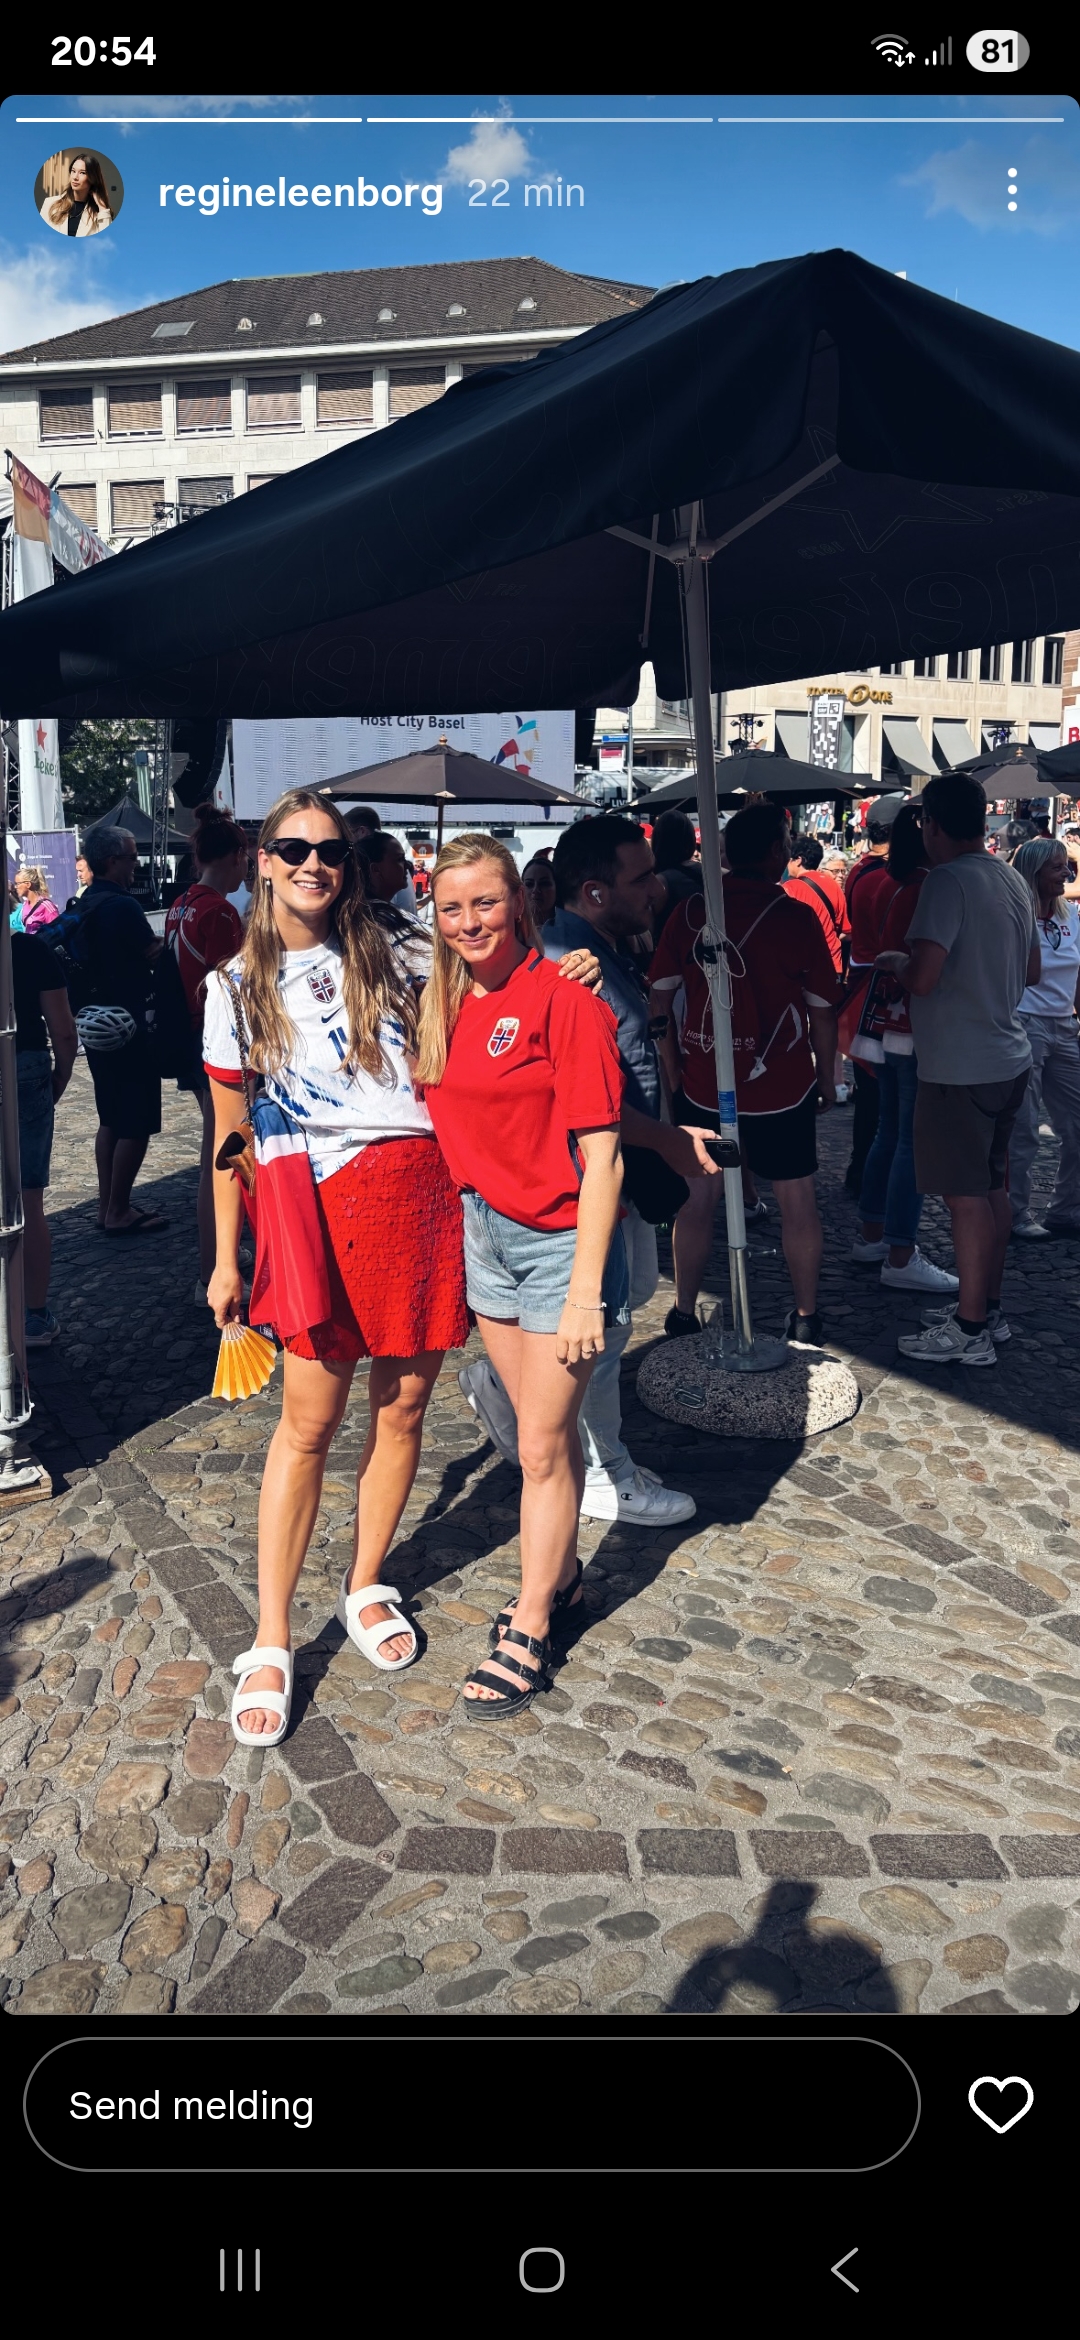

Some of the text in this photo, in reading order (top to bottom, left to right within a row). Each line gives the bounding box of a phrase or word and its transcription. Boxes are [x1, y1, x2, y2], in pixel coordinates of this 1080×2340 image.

[360, 716, 466, 731] Host City Basel
